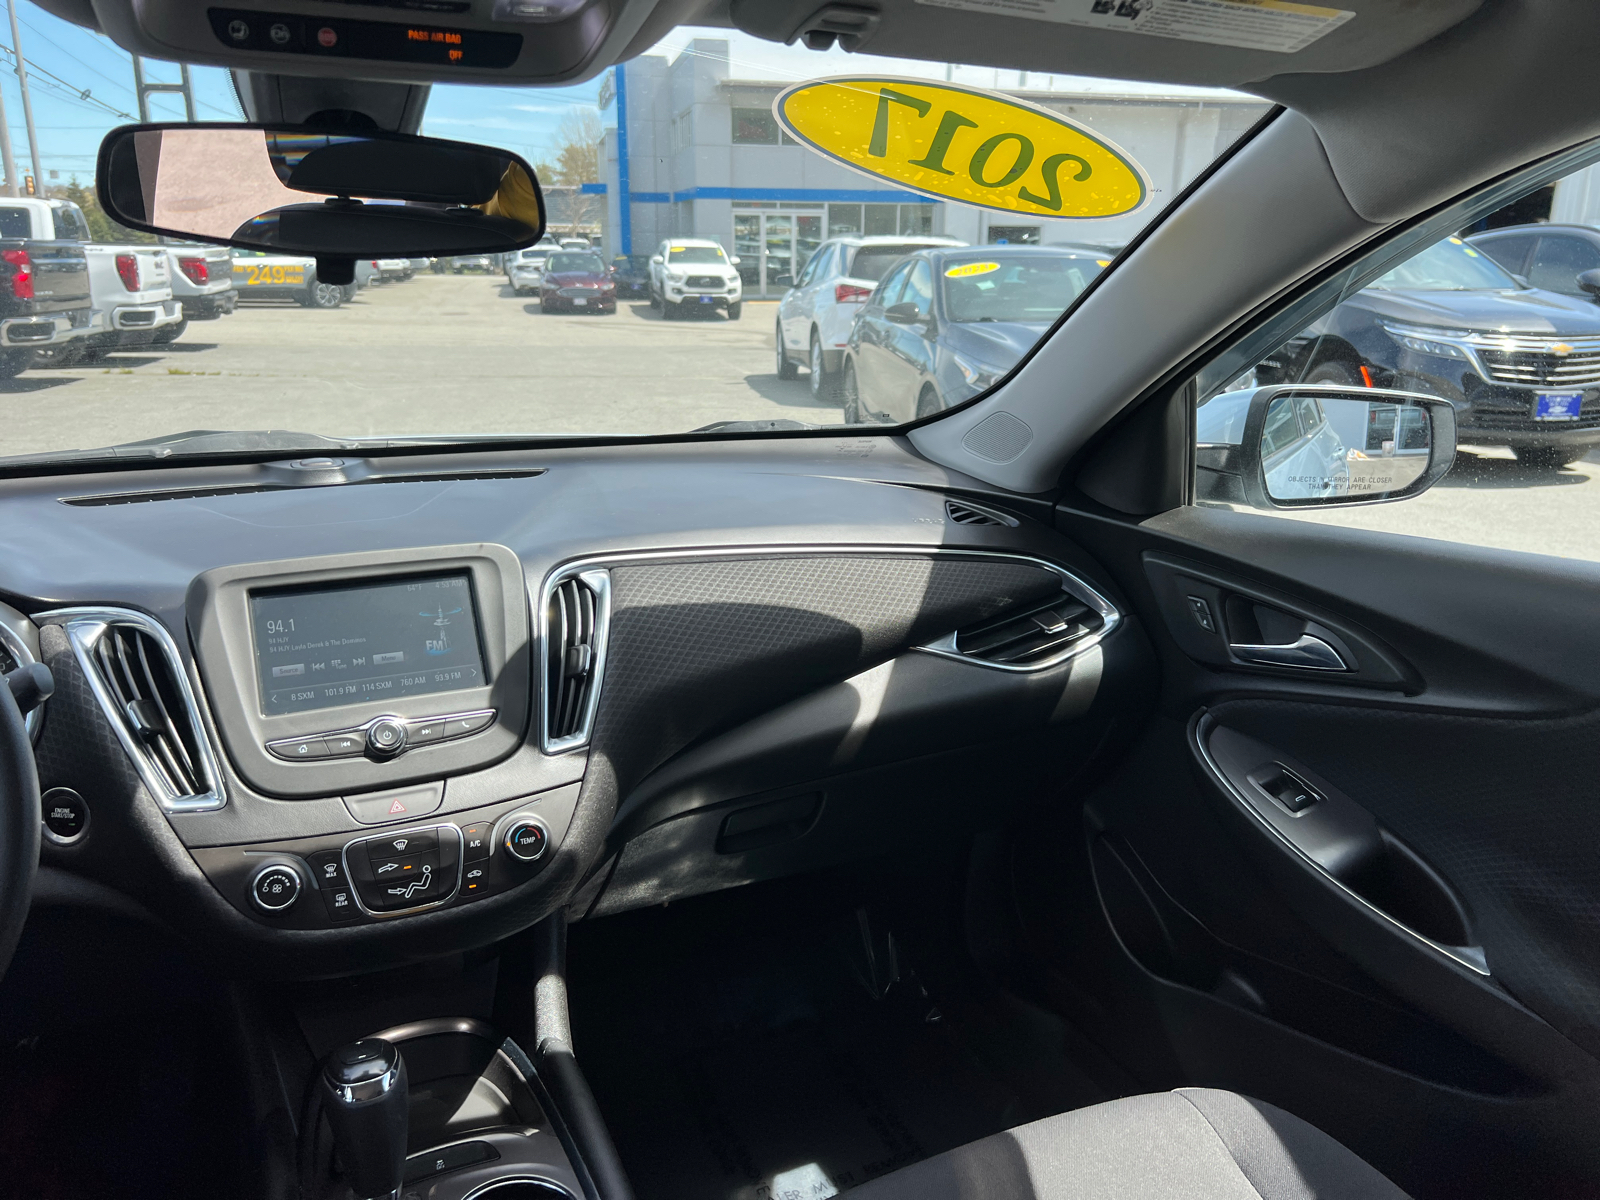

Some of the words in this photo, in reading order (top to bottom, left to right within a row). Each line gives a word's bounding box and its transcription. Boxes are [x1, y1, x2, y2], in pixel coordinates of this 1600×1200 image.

[408, 30, 429, 41] PASS
[431, 33, 444, 42] AIR
[445, 33, 462, 44] BAG
[449, 50, 463, 60] OFF
[267, 618, 295, 634] 94.1
[307, 641, 324, 649] Derek
[425, 640, 444, 651] FM
[279, 667, 299, 675] Source
[414, 676, 426, 685] AM
[434, 673, 450, 682] 93.9
[450, 671, 462, 680] FM
[325, 687, 344, 697] 101.9
[345, 685, 357, 694] FM
[362, 682, 375, 692] 114
[376, 680, 393, 690] SXM
[297, 691, 315, 700] SXM
[469, 839, 481, 848] A/C
[520, 836, 536, 846] TEMP
